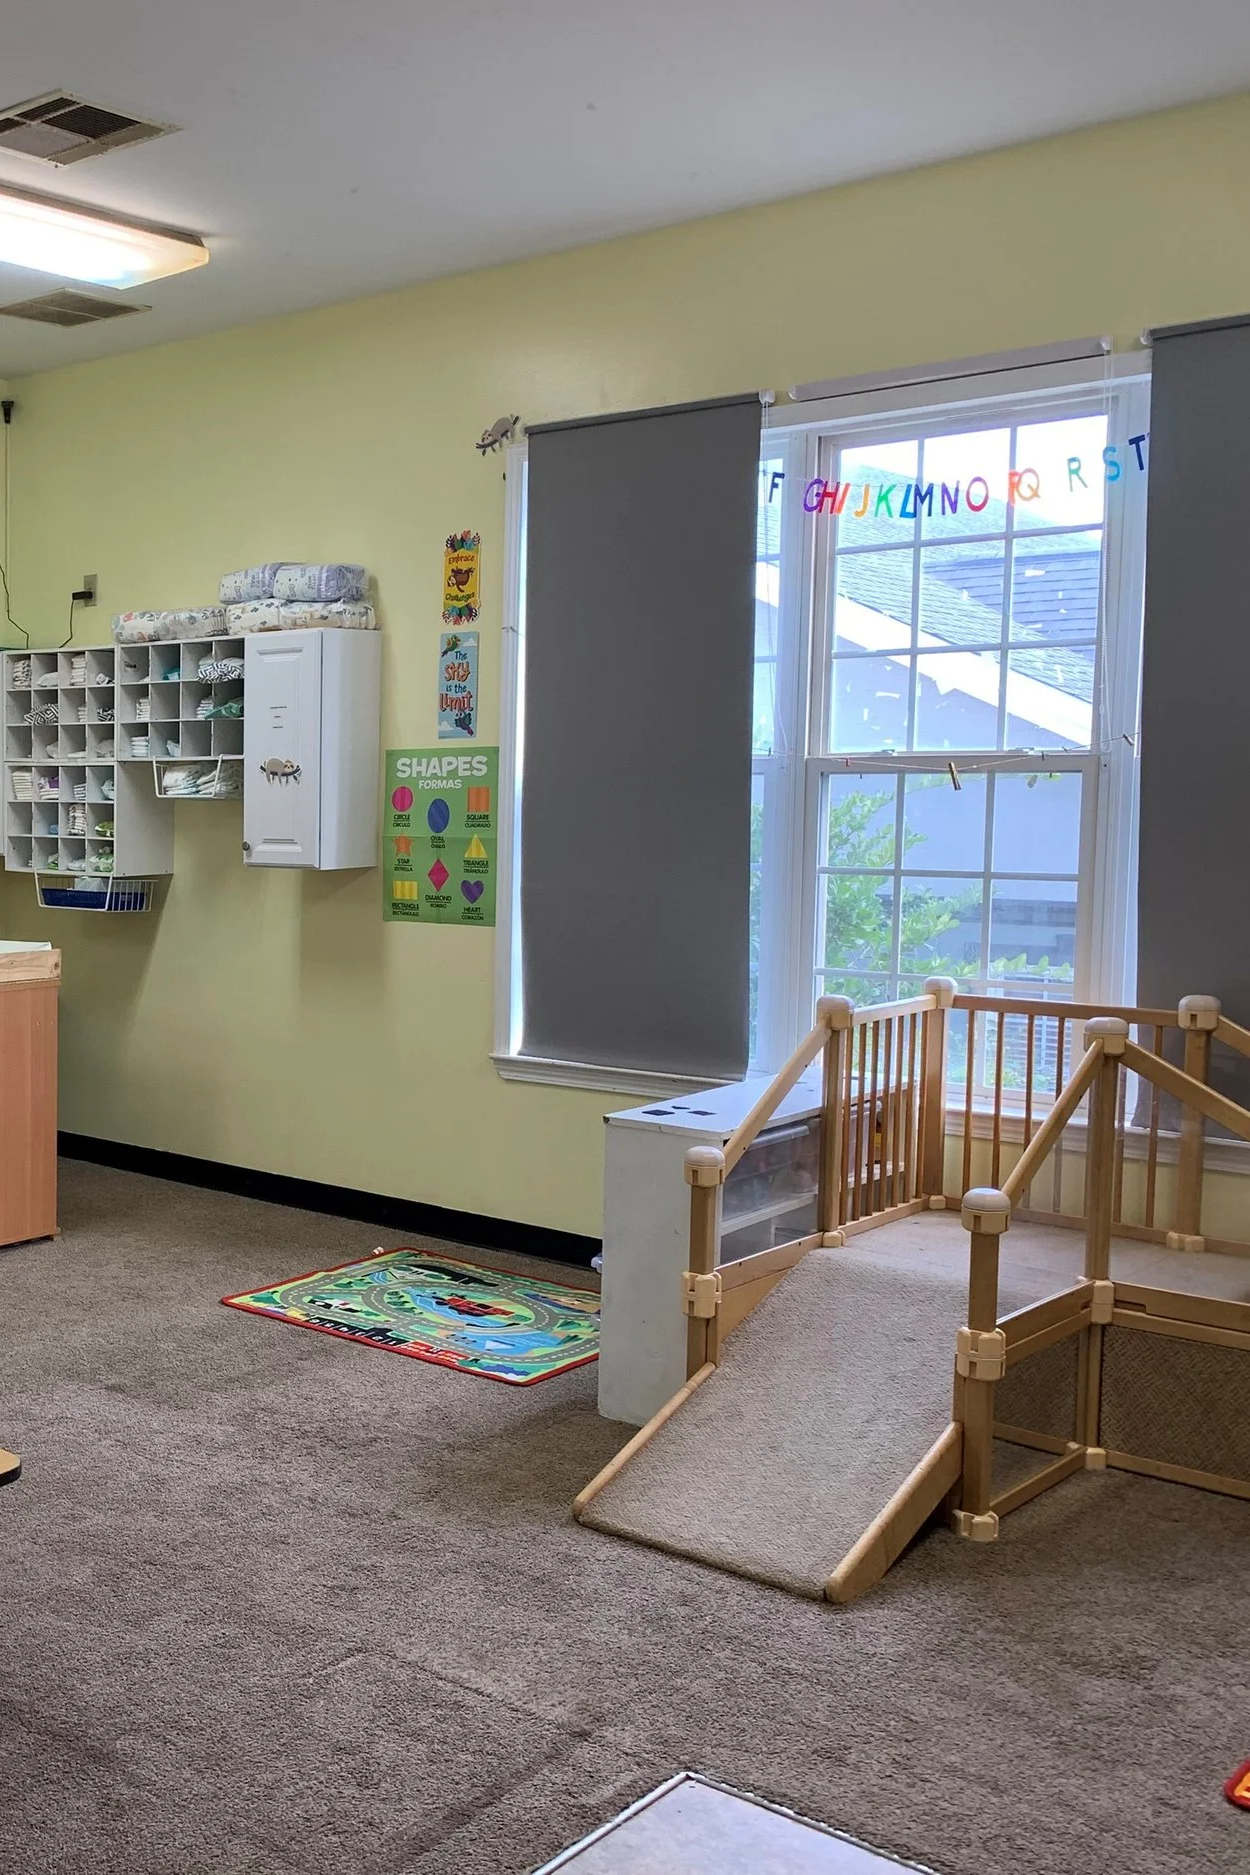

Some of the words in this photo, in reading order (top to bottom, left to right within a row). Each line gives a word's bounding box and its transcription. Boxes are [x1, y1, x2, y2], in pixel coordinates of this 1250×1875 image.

[455, 651, 467, 660] The
[455, 684, 467, 693] the
[396, 755, 488, 778] SHAPES
[419, 780, 462, 789] FORMAS
